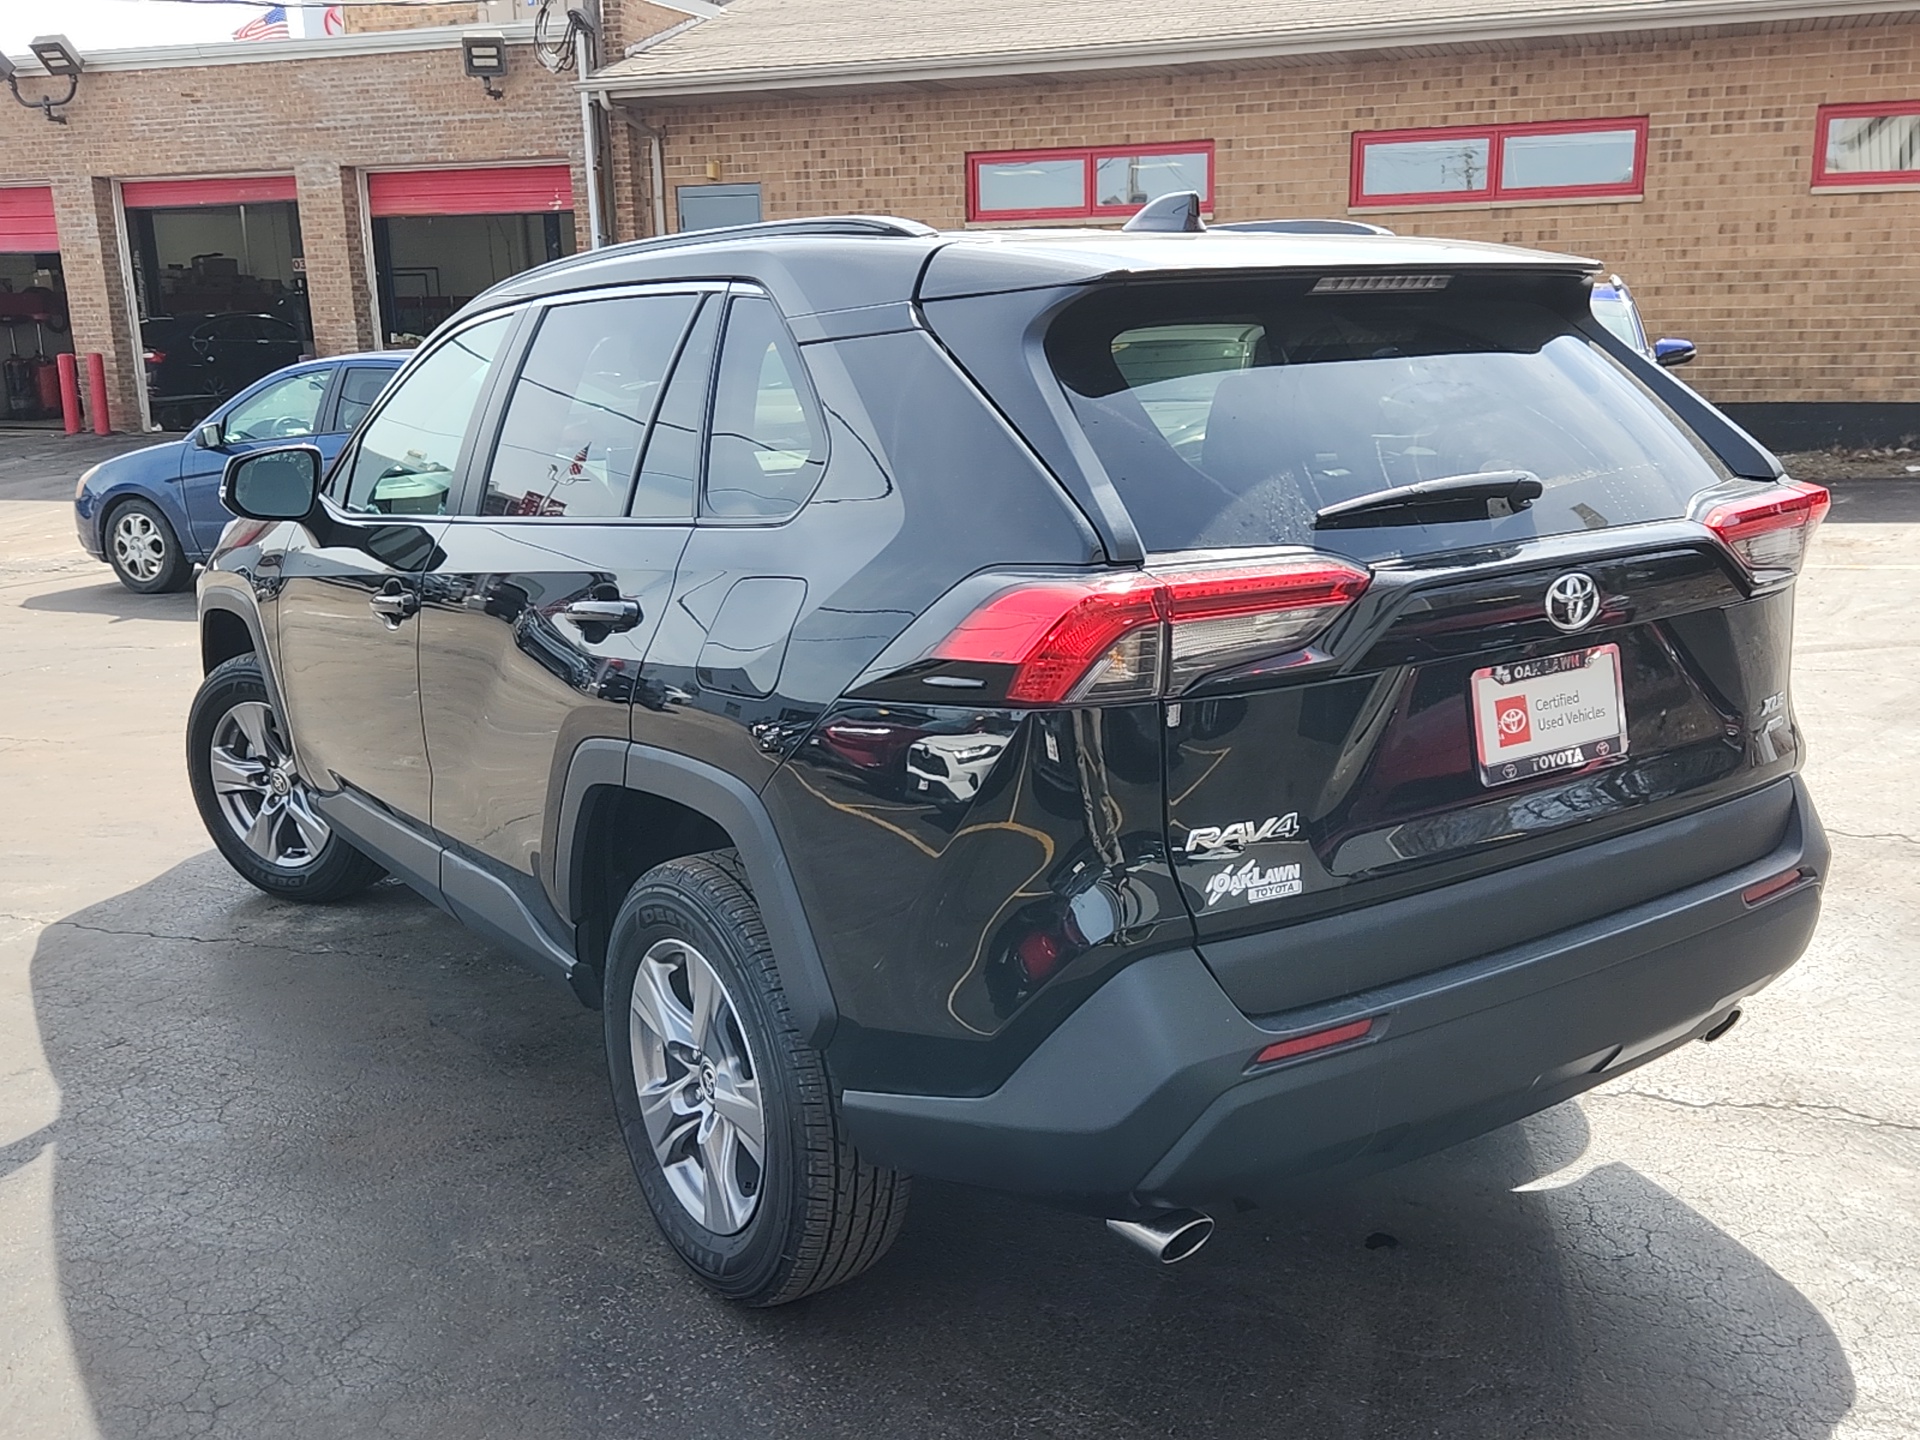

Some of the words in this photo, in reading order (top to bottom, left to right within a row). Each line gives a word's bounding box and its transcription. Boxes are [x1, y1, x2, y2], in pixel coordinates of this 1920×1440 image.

[1513, 662, 1541, 679] OAK
[1545, 654, 1581, 673] LAWN
[1535, 690, 1580, 711] Certified
[1538, 715, 1564, 732] Used
[1566, 706, 1606, 726] Vehicles
[1530, 747, 1585, 771] TOYOTA
[1185, 812, 1300, 852] RAV4
[1254, 884, 1295, 899] TOYOTA
